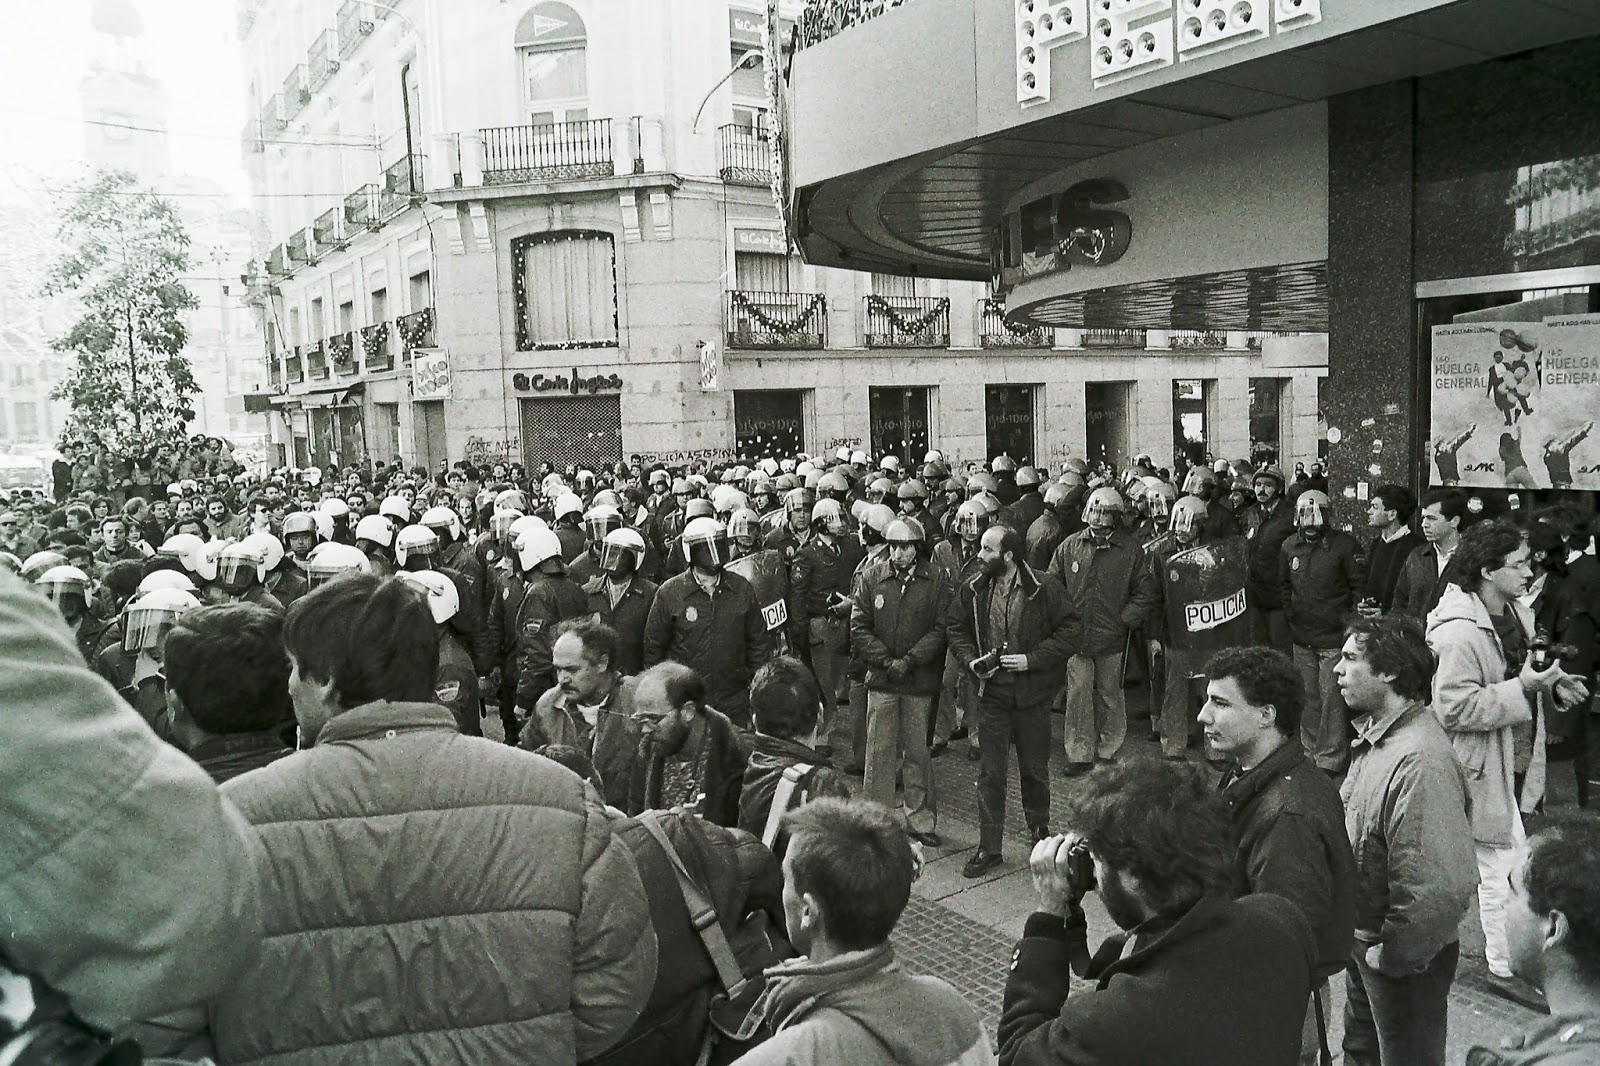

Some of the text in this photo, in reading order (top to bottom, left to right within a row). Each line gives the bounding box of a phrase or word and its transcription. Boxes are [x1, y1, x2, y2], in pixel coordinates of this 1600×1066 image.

[1435, 362, 1480, 375] HUELGA
[1546, 356, 1599, 370] HUELGA
[1435, 376, 1487, 389] GENERAL
[1186, 590, 1245, 627] POLICIA
